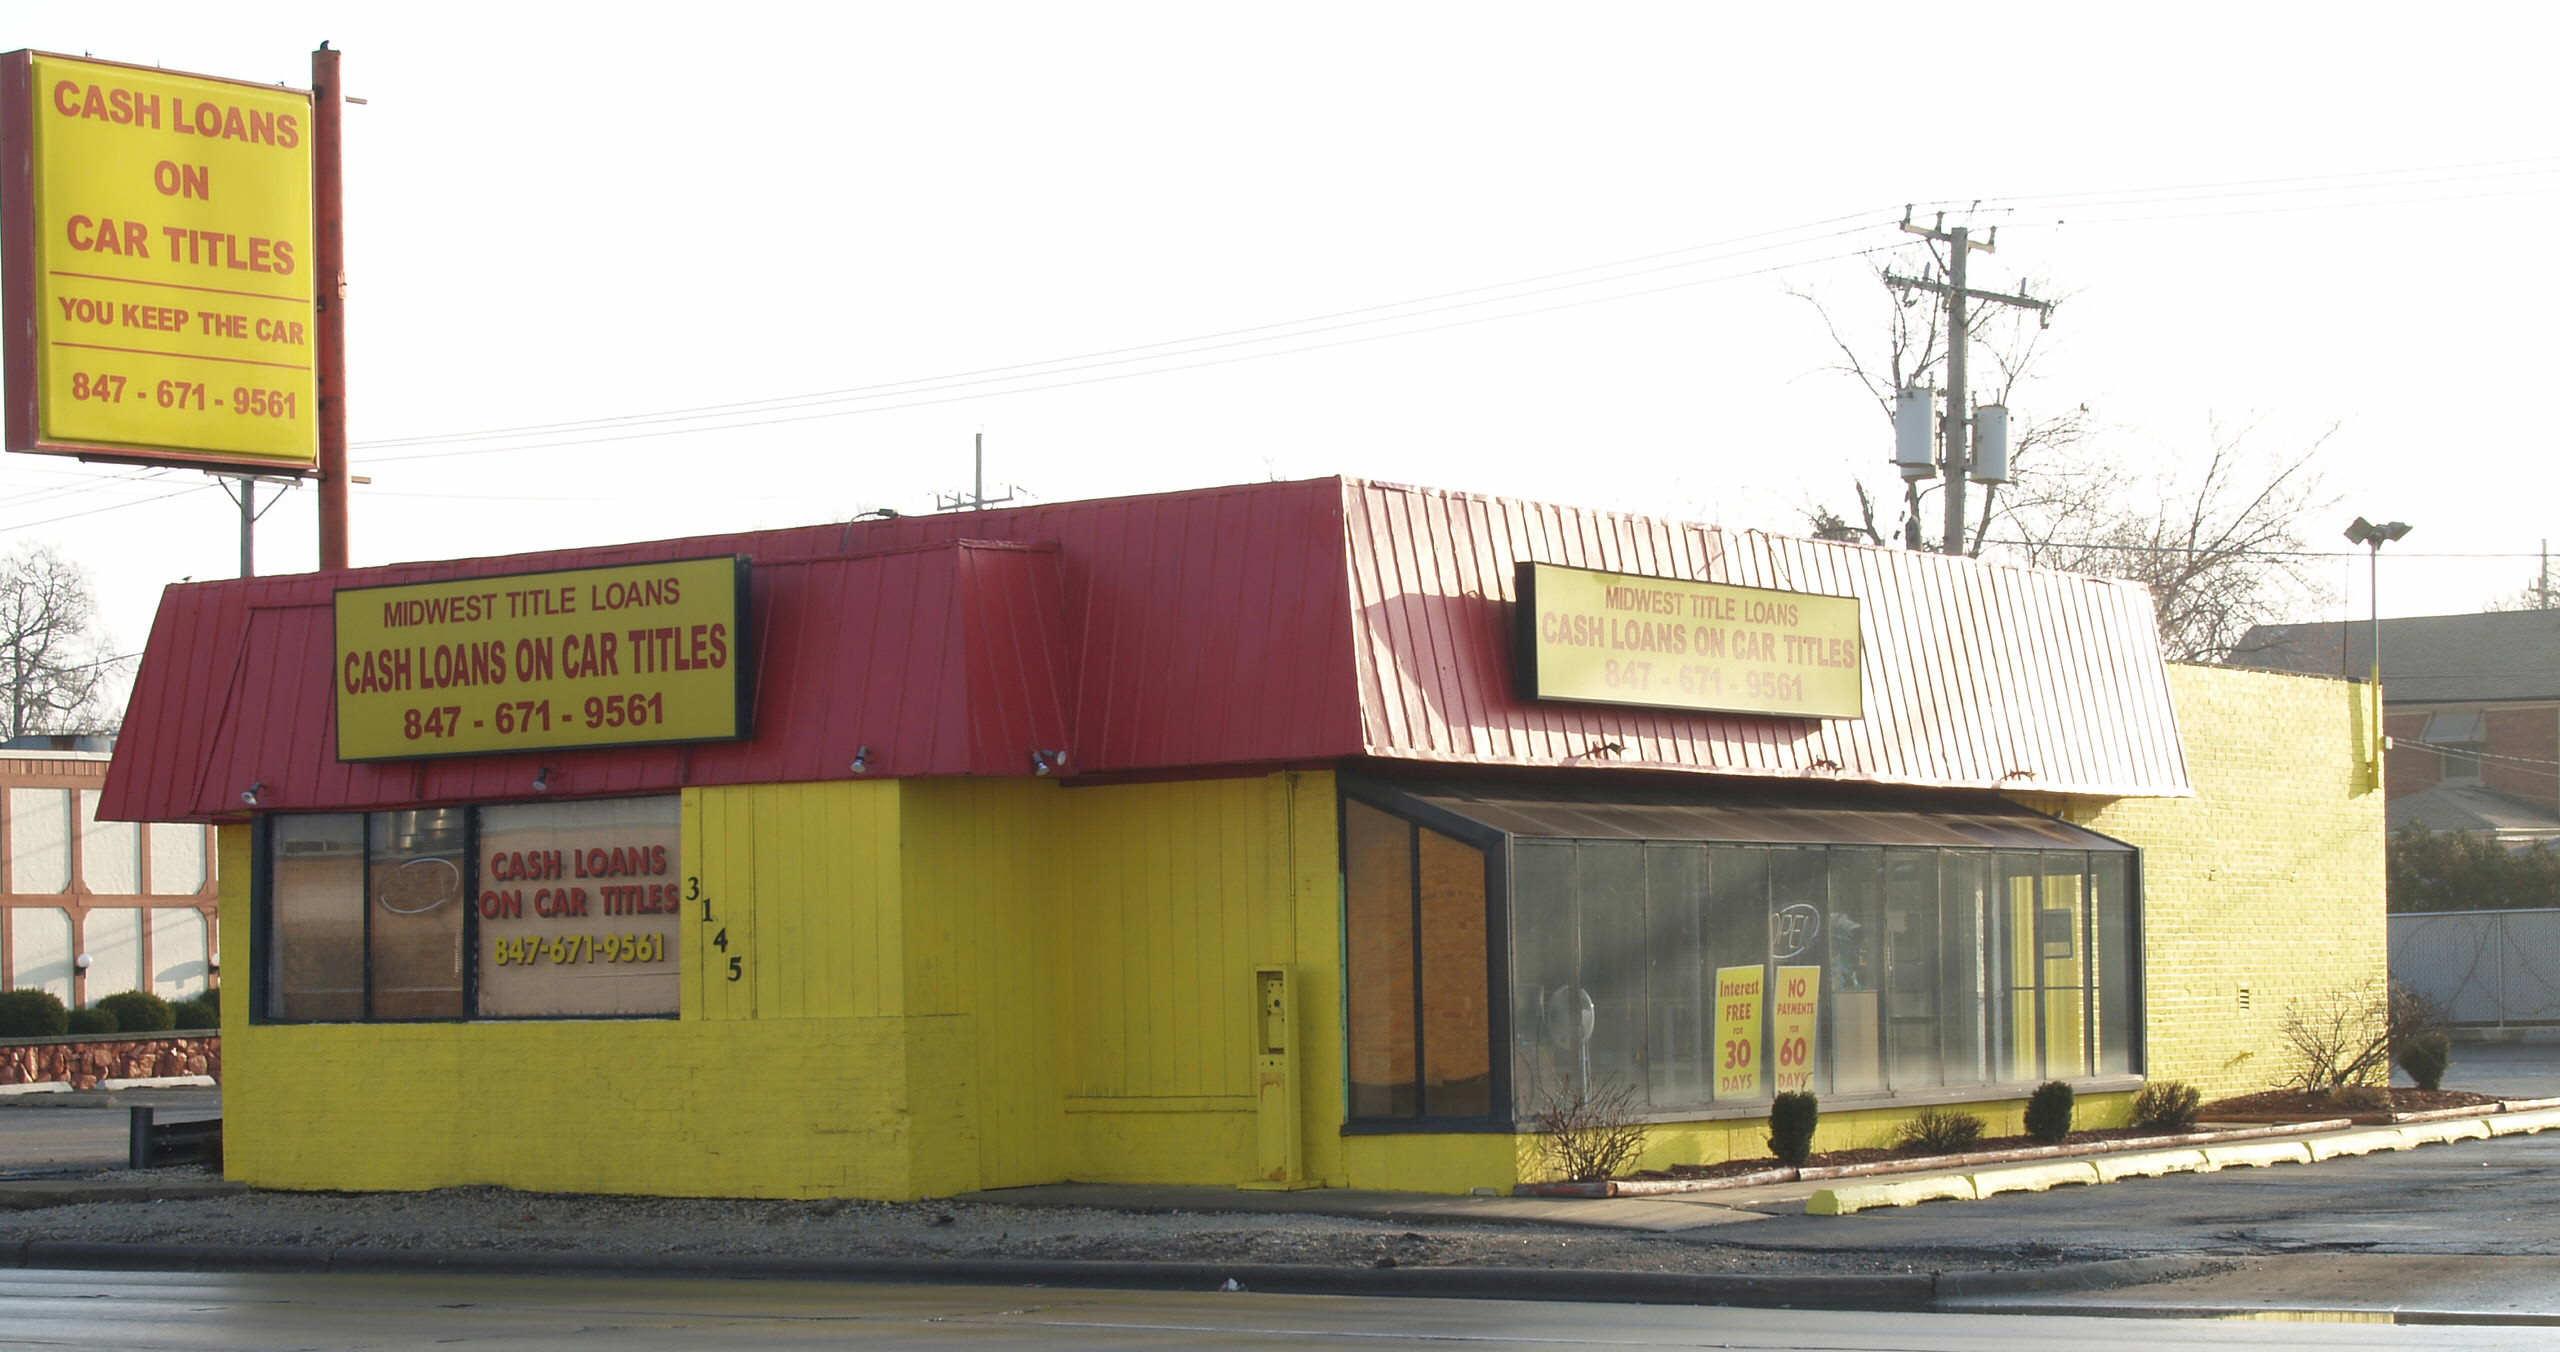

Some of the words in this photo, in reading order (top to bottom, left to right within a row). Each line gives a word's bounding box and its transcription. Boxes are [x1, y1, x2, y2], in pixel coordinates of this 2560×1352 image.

[54, 80, 161, 130] CASH
[173, 97, 299, 149] LOANS
[154, 160, 209, 201] ON
[66, 214, 150, 258] CAR
[162, 226, 295, 275] TITLES
[58, 296, 114, 326] YOU
[122, 304, 189, 333] KEEP
[198, 311, 247, 340] THE
[255, 318, 304, 345] CAR
[72, 372, 127, 402] 847
[156, 379, 205, 410] 671
[233, 386, 296, 419] 9561
[383, 593, 497, 628] MIDWEST
[505, 586, 576, 618] TITLE
[591, 577, 681, 612] LOANS
[1605, 584, 1684, 617] MIDWEST
[1689, 594, 1735, 621] TITLE
[1744, 599, 1798, 627] LOANS
[344, 647, 411, 694] CASH
[419, 640, 506, 689] LOANS
[515, 636, 553, 682] ON
[562, 631, 618, 679] CAR
[628, 623, 727, 674] TITLES
[1541, 611, 1605, 649] CASH
[1611, 617, 1688, 656] LOANS
[1694, 625, 1726, 658] ON
[1732, 630, 1776, 663] CAR
[1783, 634, 1856, 669] TITLES
[1605, 659, 1652, 690] 847
[1679, 663, 1722, 697] 671
[1746, 670, 1804, 700] 9561
[404, 706, 461, 740] 847
[495, 700, 550, 734] 671
[583, 692, 663, 729] 9561
[490, 850, 562, 881] CASH
[574, 844, 667, 880] LOANS
[480, 890, 522, 919] ON
[534, 886, 588, 919] CAR
[600, 882, 680, 916] TITLES
[495, 932, 664, 966] 847-671-9561
[1720, 978, 1760, 997] Interest
[1788, 977, 1806, 997] NO
[1725, 1002, 1752, 1022] FREE
[1777, 1002, 1814, 1016] PAYMENTS
[1724, 1038, 1752, 1069] 30
[1780, 1037, 1807, 1066] 60
[1722, 1073, 1753, 1092] DAYS
[1778, 1072, 1809, 1090] DAYS
